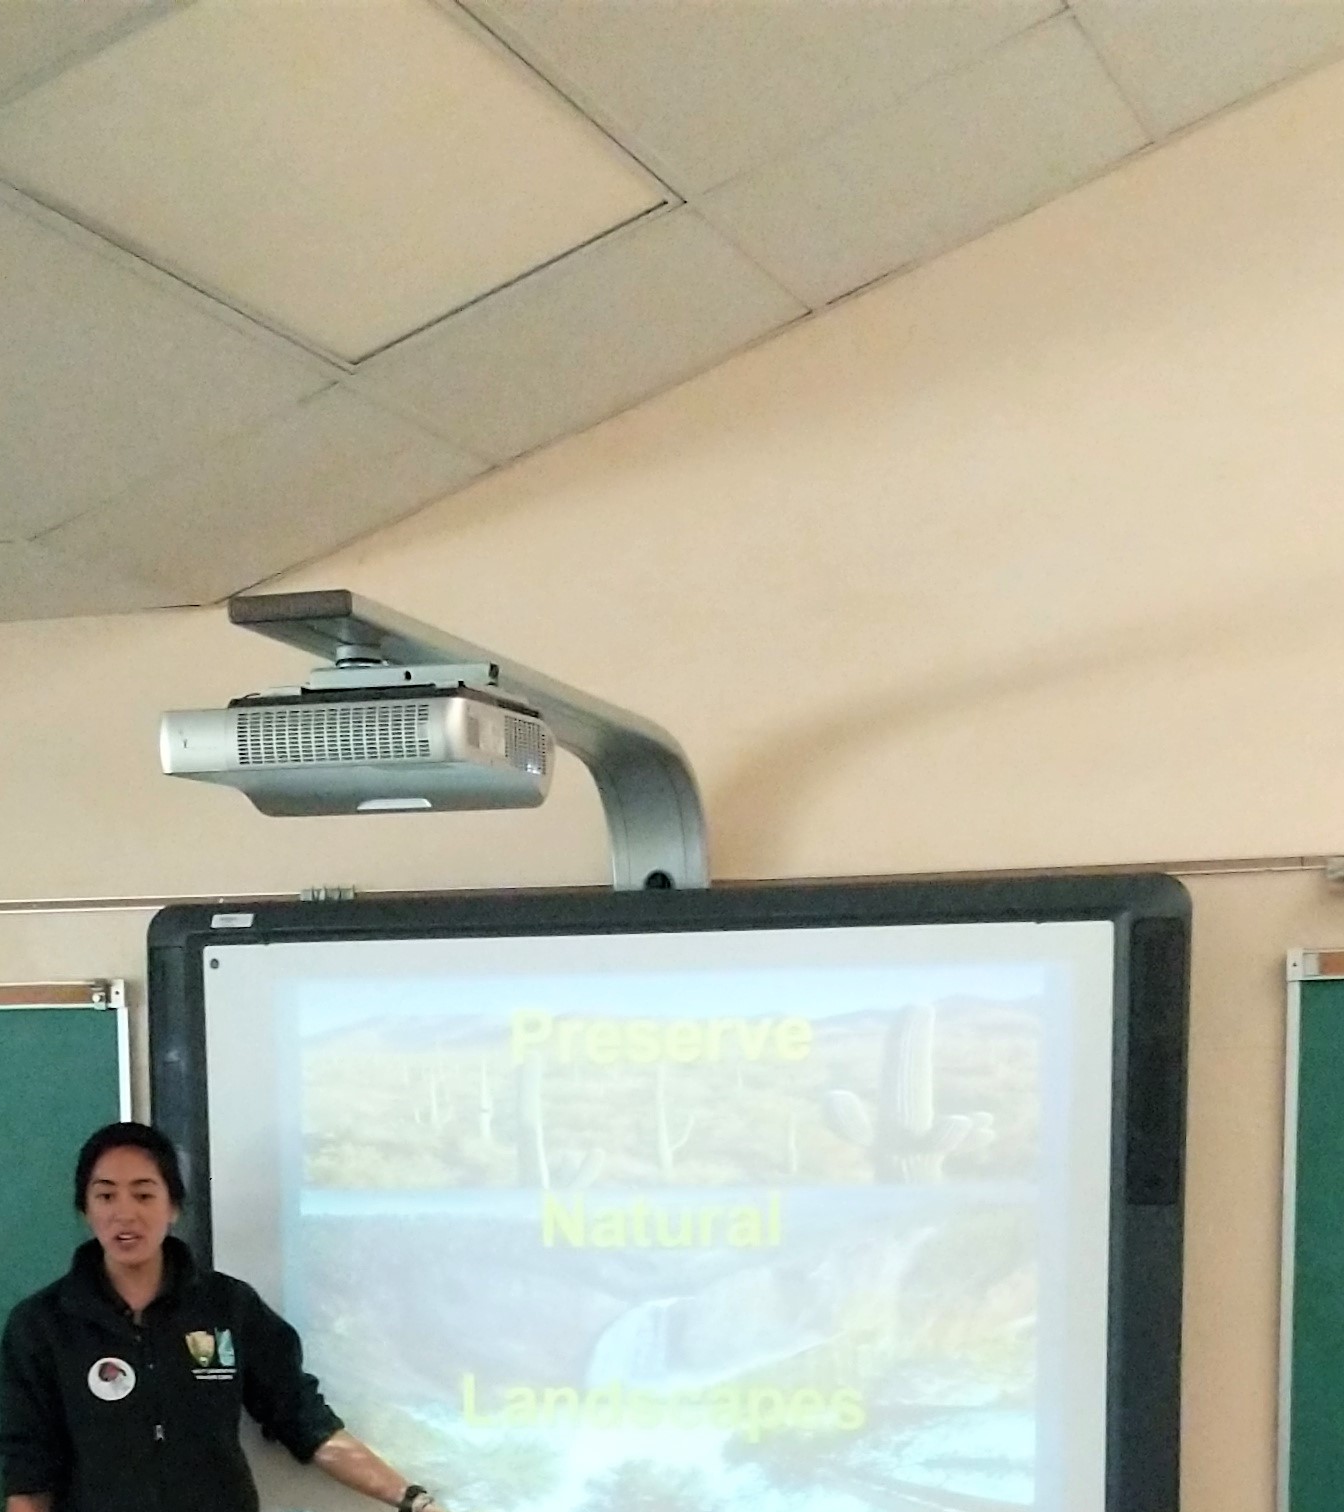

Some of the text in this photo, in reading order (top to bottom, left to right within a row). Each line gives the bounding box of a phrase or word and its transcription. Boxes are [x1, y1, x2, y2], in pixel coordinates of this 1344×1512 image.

[509, 1007, 815, 1066] Preserve
[540, 1189, 784, 1251] Natural
[461, 1371, 867, 1441] Landscapes
